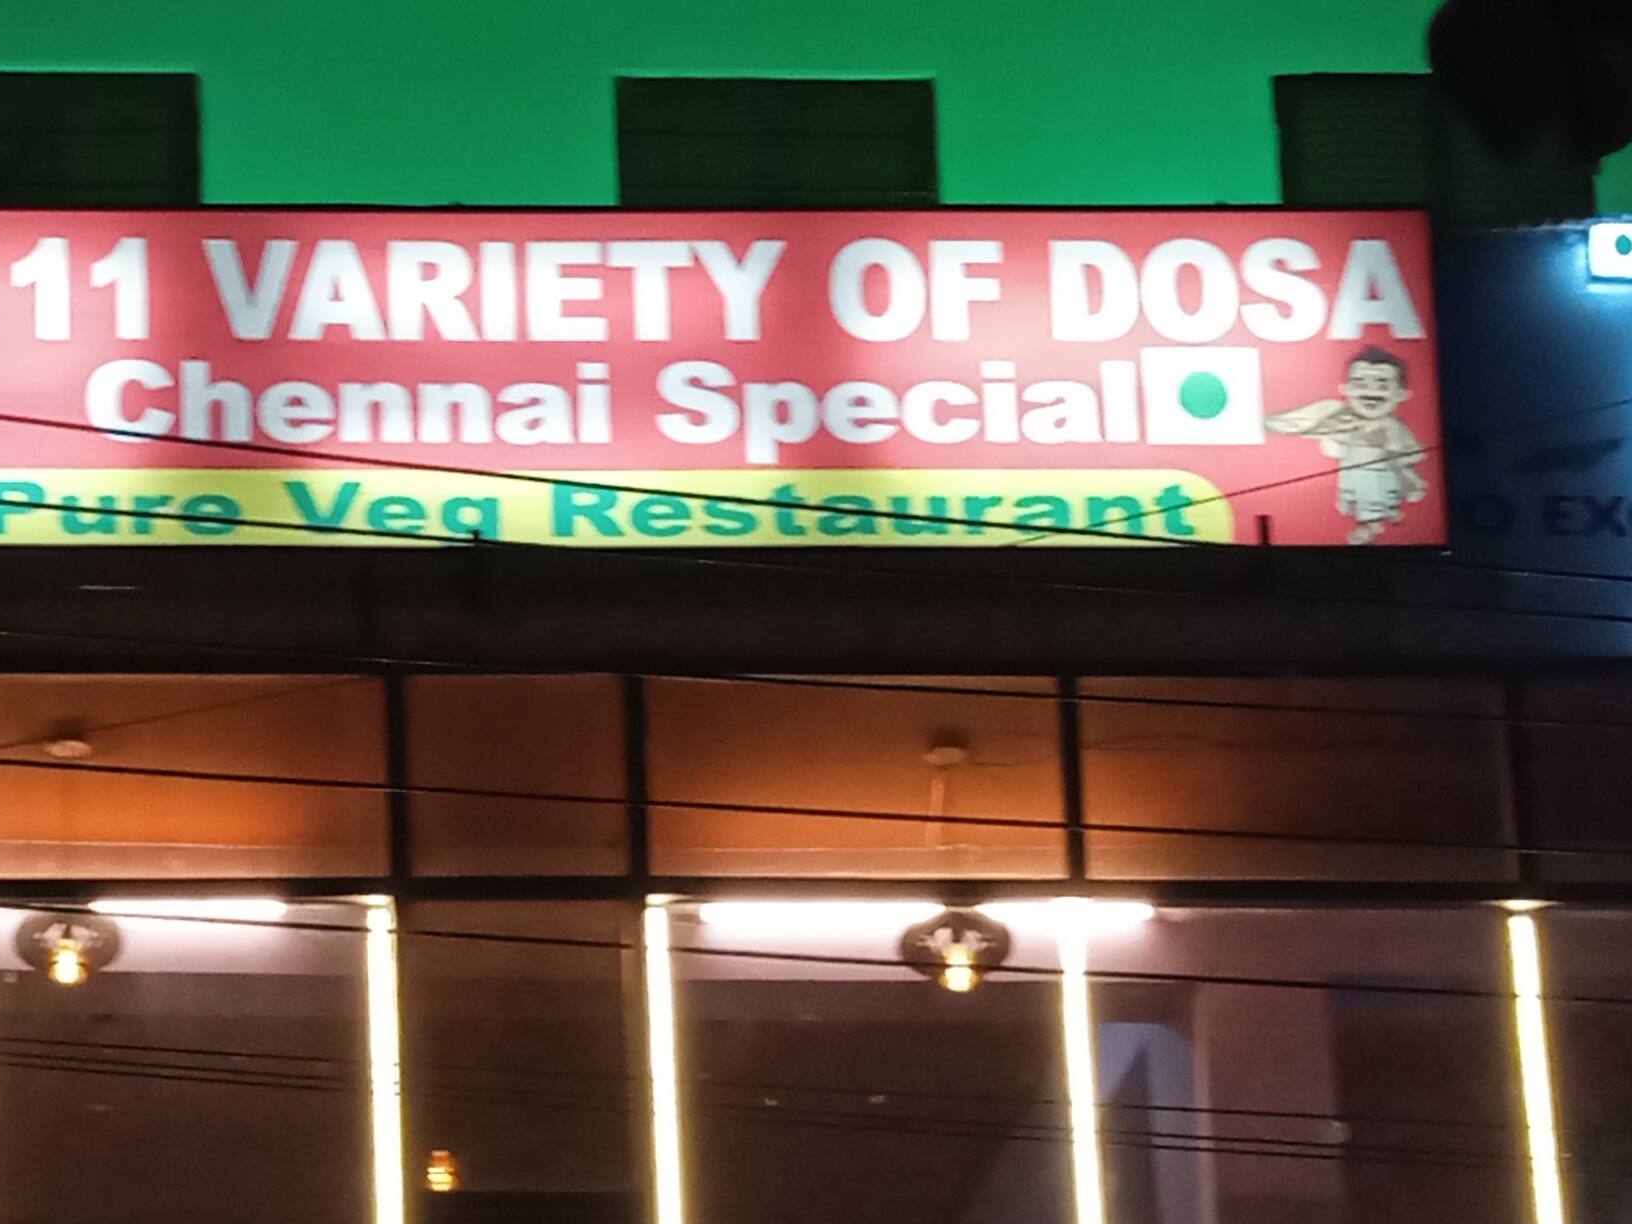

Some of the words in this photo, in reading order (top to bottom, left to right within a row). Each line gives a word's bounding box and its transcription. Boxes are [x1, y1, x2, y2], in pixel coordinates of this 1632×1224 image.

[202, 238, 786, 343] VARIETY
[827, 237, 1002, 344] OF
[1048, 237, 1426, 344] DOSA
[84, 359, 612, 445] Chennai
[654, 359, 1141, 464] Special
[283, 482, 500, 542] Veg
[553, 481, 1196, 538] Restaurant
